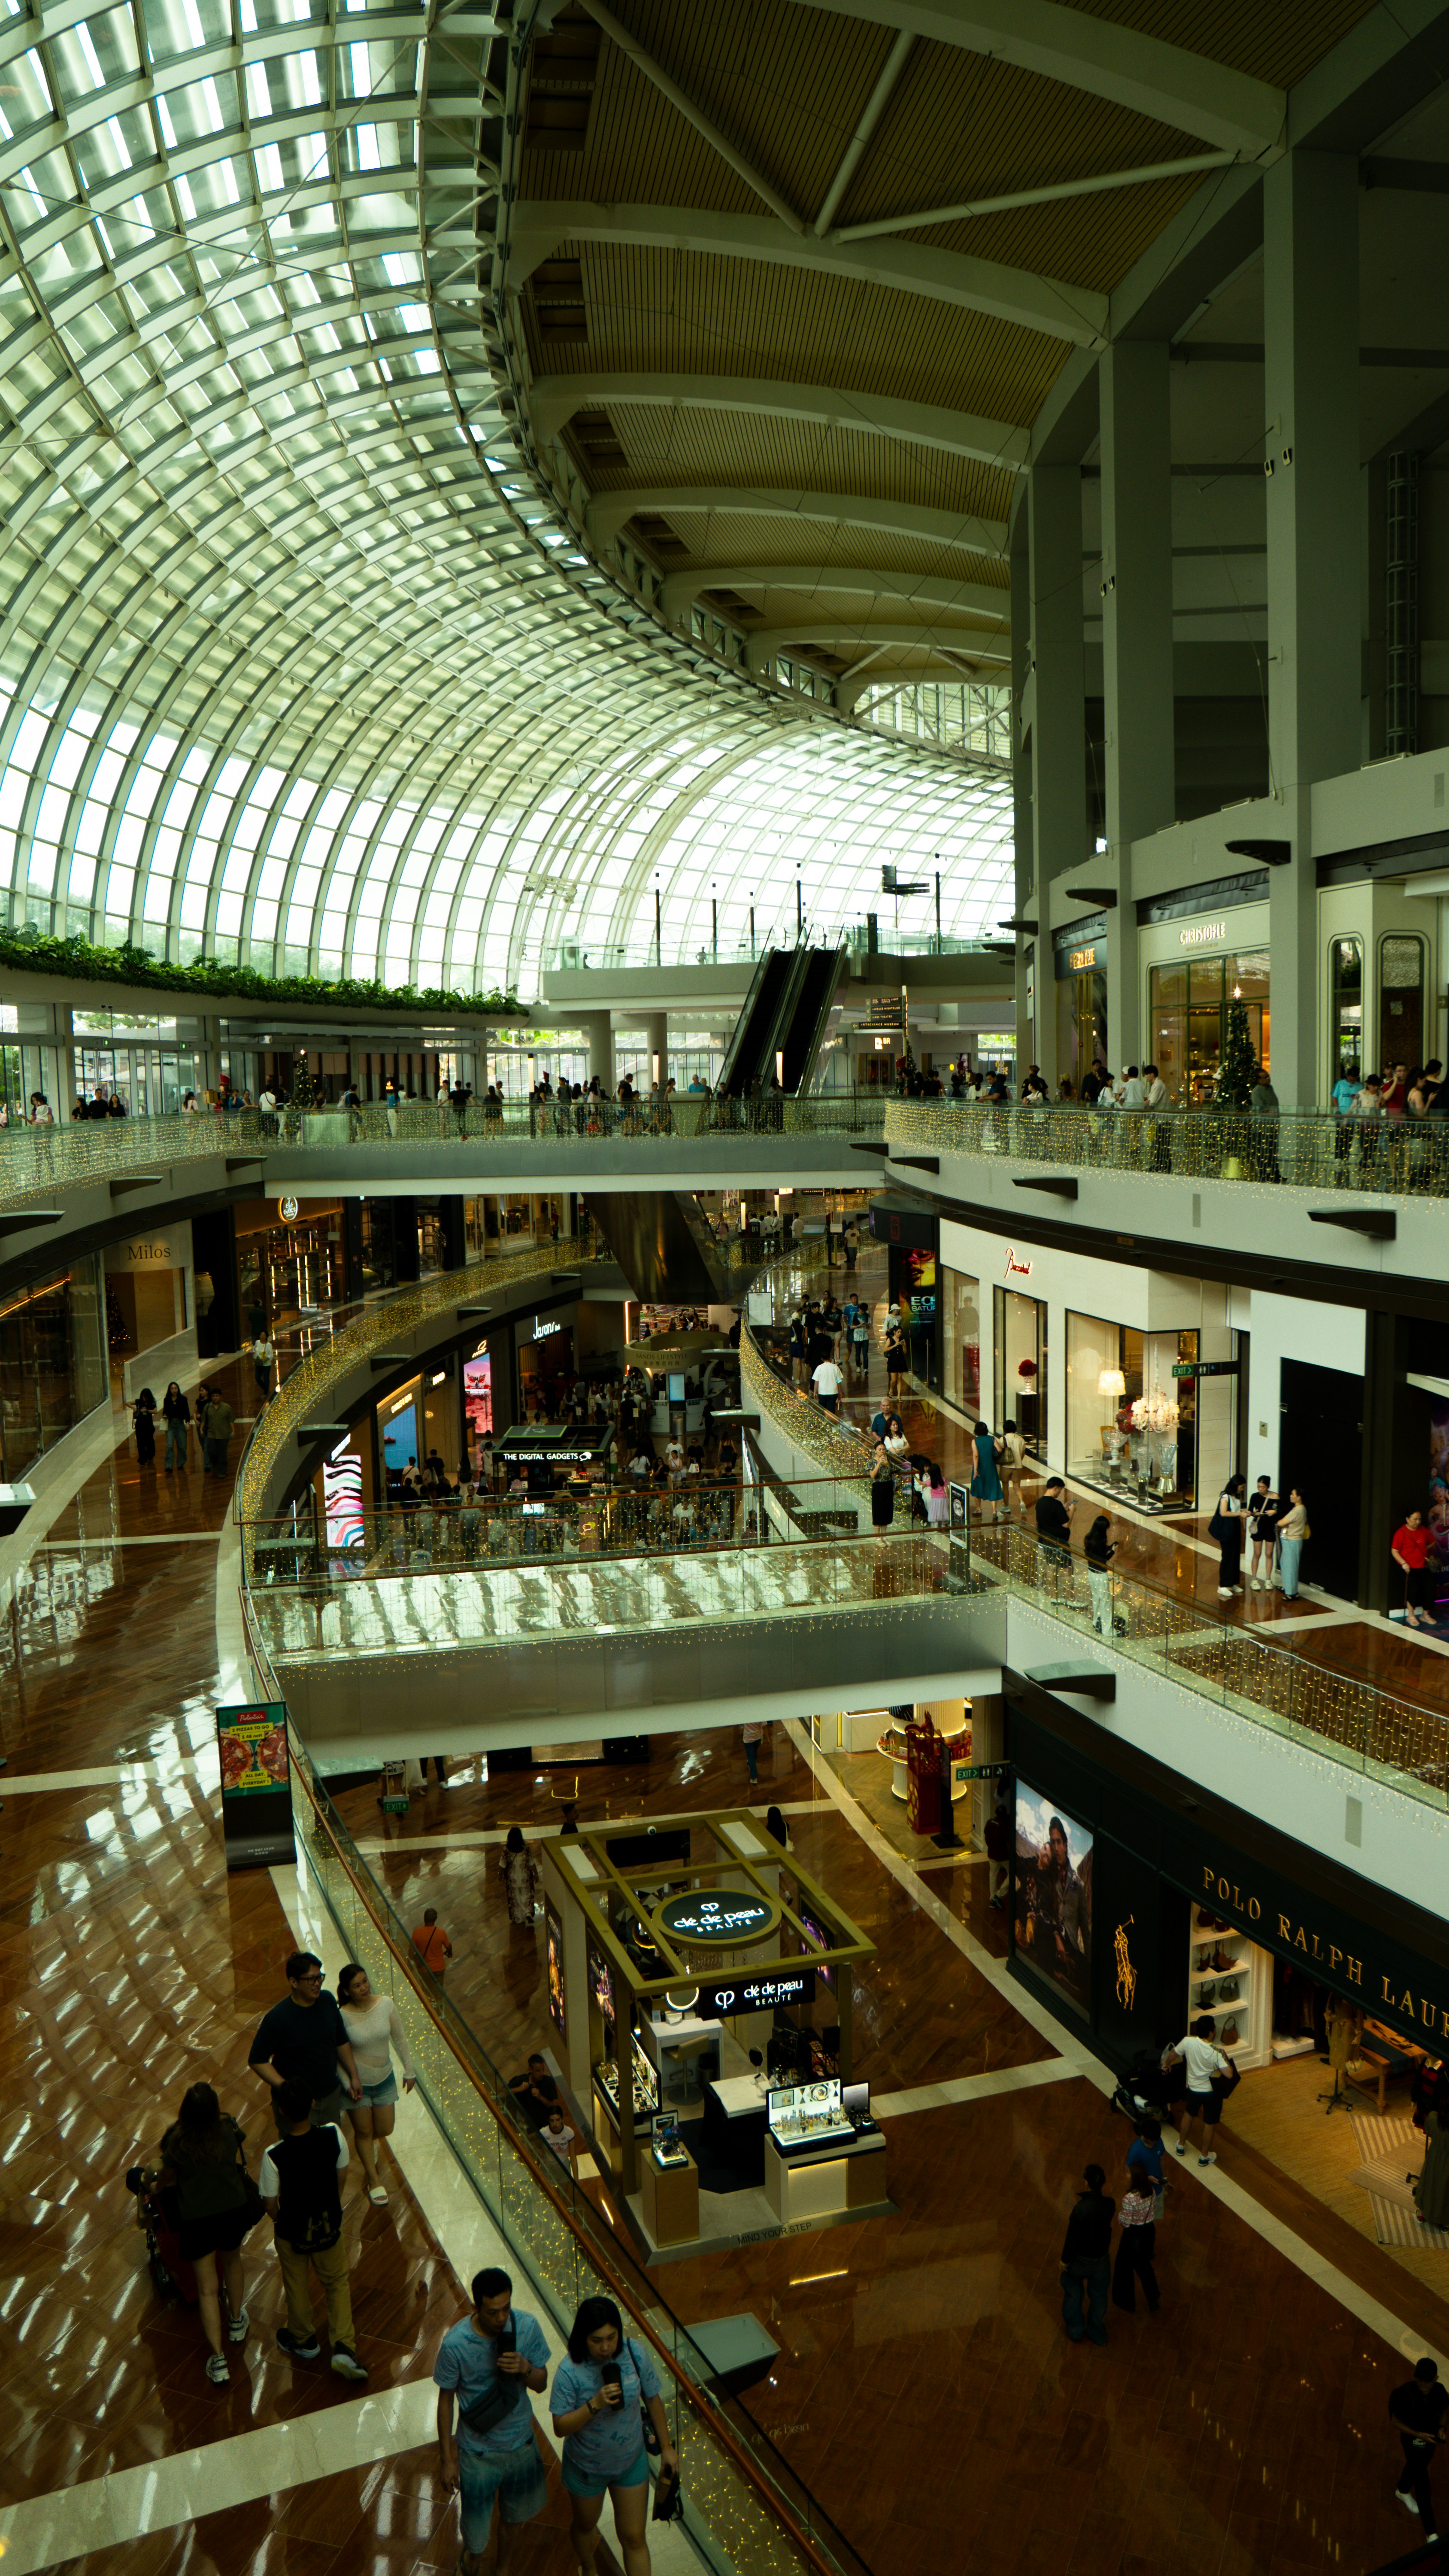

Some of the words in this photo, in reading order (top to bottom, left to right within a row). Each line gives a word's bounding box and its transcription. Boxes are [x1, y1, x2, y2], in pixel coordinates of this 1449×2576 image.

[1179, 922, 1225, 945] CHRISTOFLE
[127, 1245, 171, 1260] Milos
[958, 1770, 971, 1778] EXIT
[674, 1917, 699, 1928] clé
[700, 1914, 723, 1924] de
[723, 1908, 764, 1923] peau
[1203, 1866, 1261, 1920] POLO
[1277, 1913, 1362, 1985] RALPH
[744, 1985, 760, 1998] clé
[761, 1982, 776, 1995] de
[777, 1979, 803, 1996] peau
[756, 1993, 791, 2006] BEAUTÉ
[738, 2233, 760, 2245] MIND
[762, 2227, 788, 2239] YOUR
[789, 2222, 812, 2233] STEP
